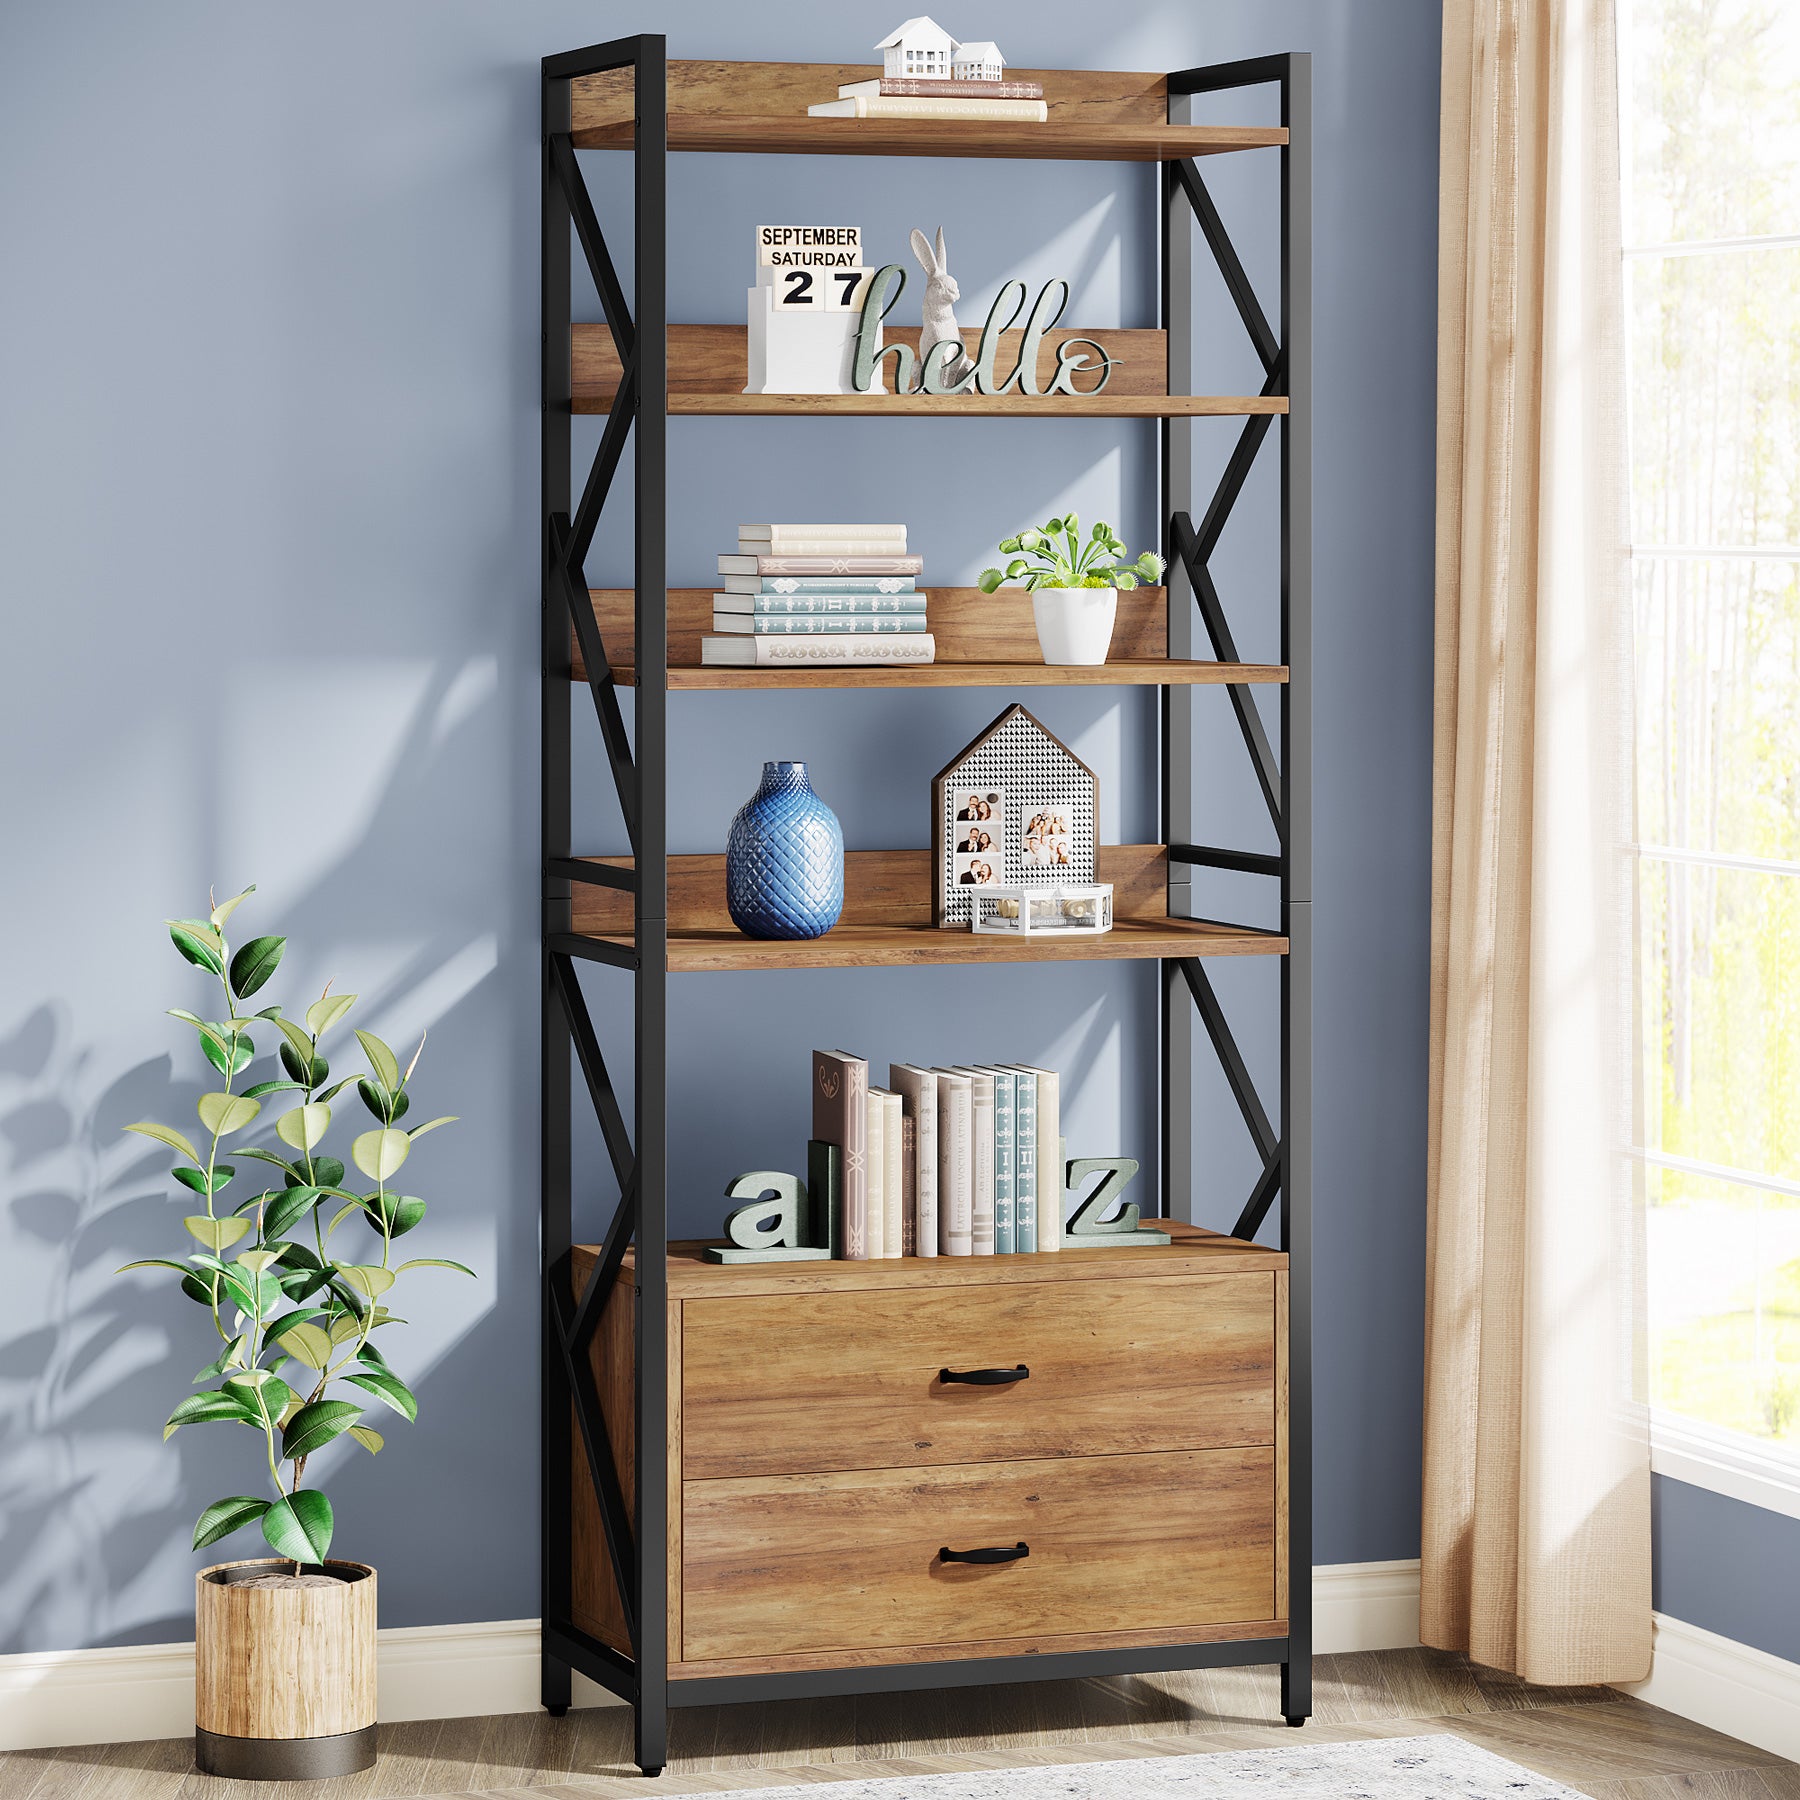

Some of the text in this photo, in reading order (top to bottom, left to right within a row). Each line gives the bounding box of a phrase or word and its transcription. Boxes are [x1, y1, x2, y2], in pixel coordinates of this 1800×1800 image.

[762, 228, 857, 246] SEPTEMBER
[771, 251, 856, 266] SATURDAY
[783, 270, 862, 306] 2 7
[852, 263, 1124, 396] hello
[956, 1091, 967, 1231] LATERCULI VOCUM LATINARUM
[1020, 1150, 1033, 1166] II
[723, 1170, 810, 1250] a
[1066, 1157, 1140, 1235] z
